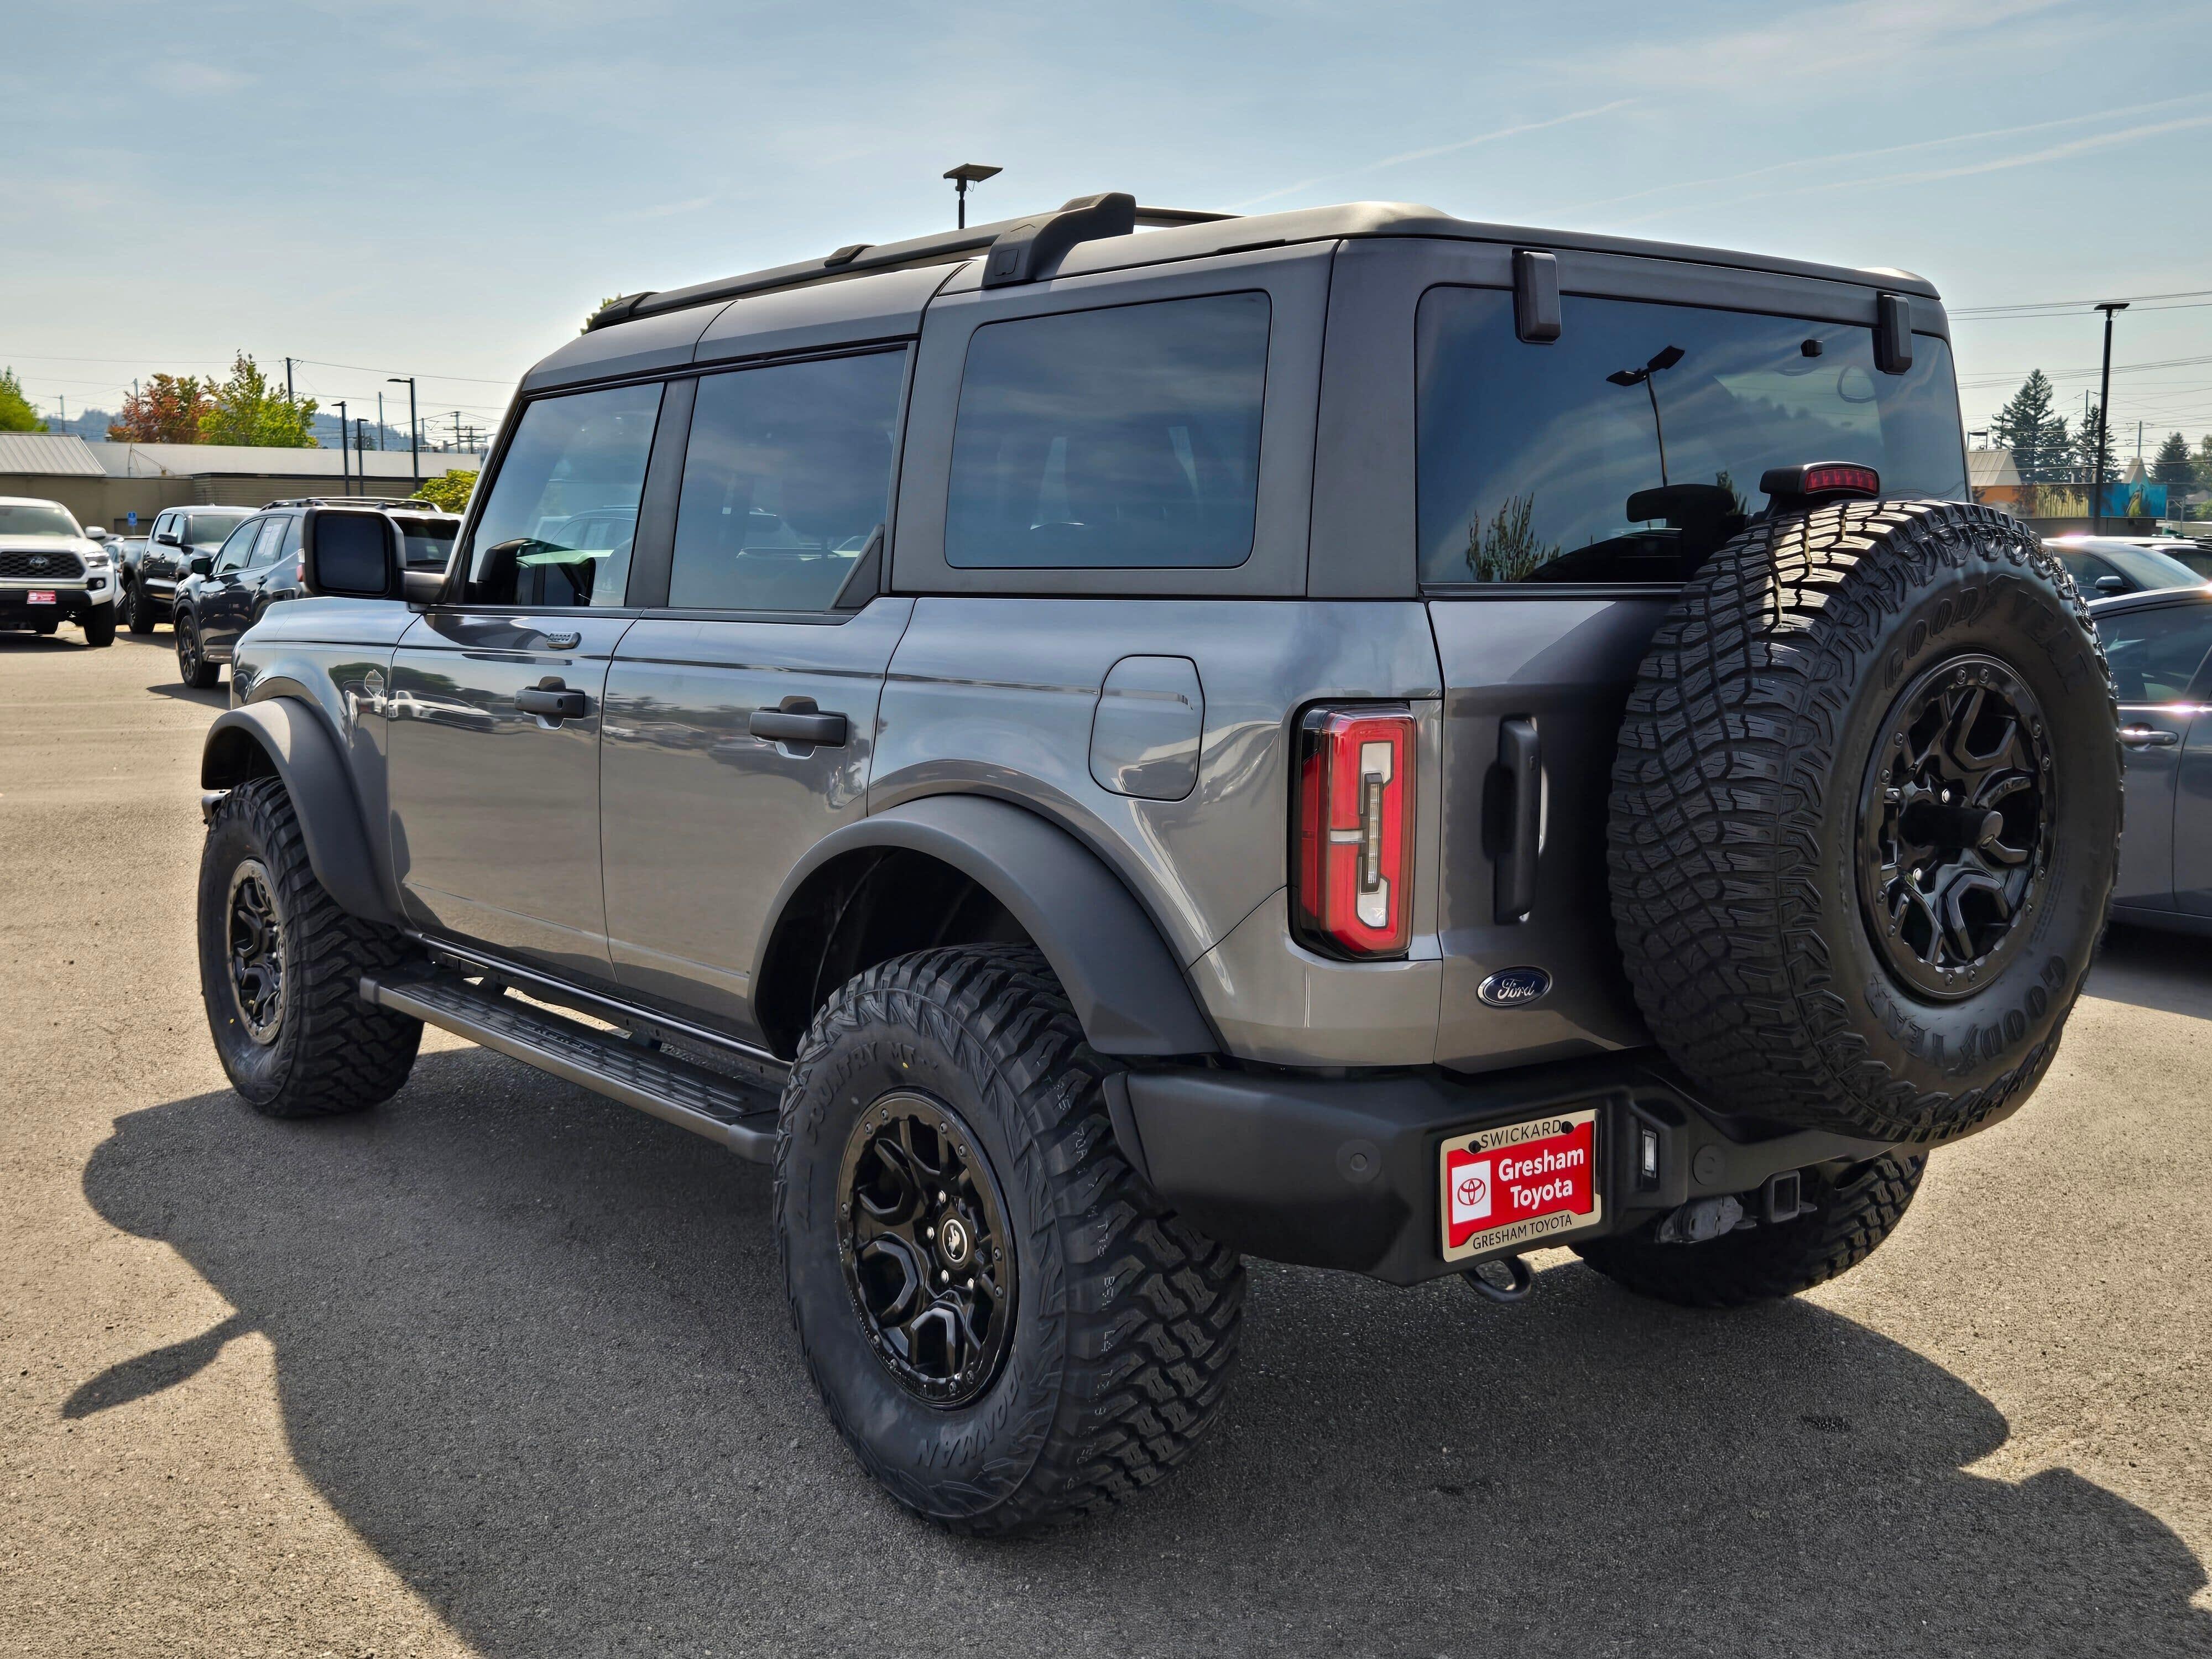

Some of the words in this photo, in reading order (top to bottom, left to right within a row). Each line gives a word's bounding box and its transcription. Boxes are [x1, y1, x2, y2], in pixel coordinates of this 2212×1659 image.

[1497, 978, 1536, 1000] Ford
[1480, 1119, 1561, 1149] SWICKARD
[1498, 1147, 1584, 1182] Gresham
[1510, 1178, 1573, 1210] Toyota
[1473, 1227, 1526, 1249] GRESHAM
[1529, 1214, 1572, 1235] TOYOTA
